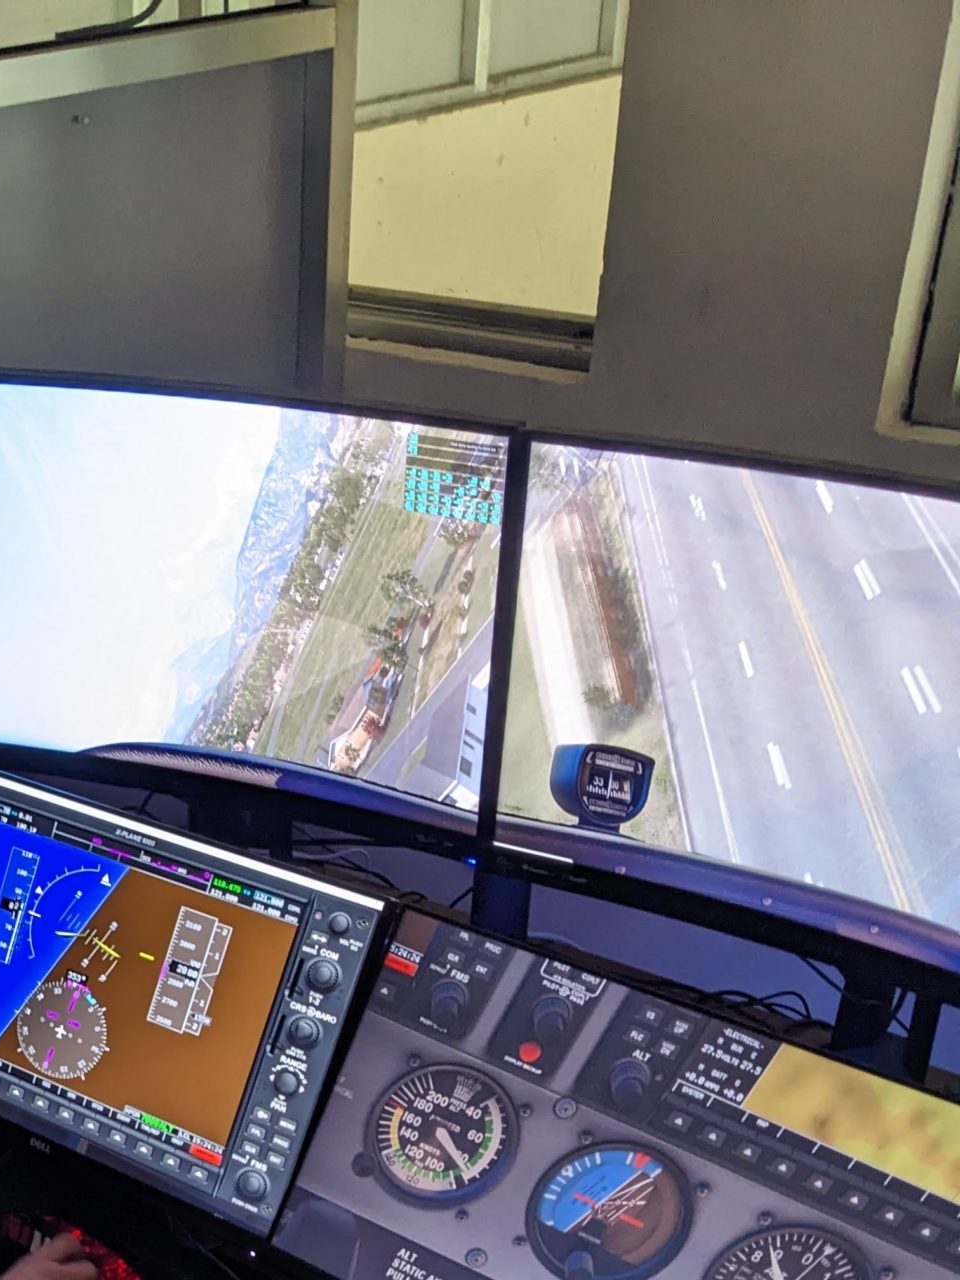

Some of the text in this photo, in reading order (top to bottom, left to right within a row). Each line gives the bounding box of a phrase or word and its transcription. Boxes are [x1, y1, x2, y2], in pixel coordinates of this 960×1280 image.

[593, 777, 604, 786] 33
[115, 830, 141, 842] X-PLANE
[320, 949, 339, 961] COM
[447, 952, 460, 962] CLR
[475, 964, 488, 974] ENT
[552, 961, 571, 972] PILOT
[450, 970, 471, 984] FMS
[542, 979, 559, 990] PILOT
[290, 1001, 337, 1024] CRS BARO
[646, 1010, 655, 1020] VS
[630, 1030, 644, 1042] FLC
[632, 1049, 651, 1063] ALT
[701, 1044, 723, 1061] 27.5
[740, 1059, 762, 1076] 27.5
[280, 1055, 308, 1072] RANGE
[681, 1085, 705, 1101] SYSTEM
[685, 1071, 705, 1086] +0.0
[723, 1088, 744, 1102] +0.0
[413, 1097, 433, 1113] 180
[426, 1091, 449, 1107] 200
[270, 1101, 286, 1113] PAN
[465, 1106, 482, 1119] 40
[402, 1111, 422, 1127] 160
[400, 1126, 419, 1142] 140
[467, 1130, 483, 1143] 60
[404, 1144, 425, 1160] 120
[419, 1142, 440, 1157] KNOTS
[250, 1159, 268, 1172] FMS
[425, 1157, 445, 1172] 100
[397, 1248, 418, 1263] ALT
[751, 1251, 763, 1263] 8
[774, 1249, 783, 1260] 9
[801, 1253, 813, 1265] 0
[391, 1258, 426, 1280] STATIC
